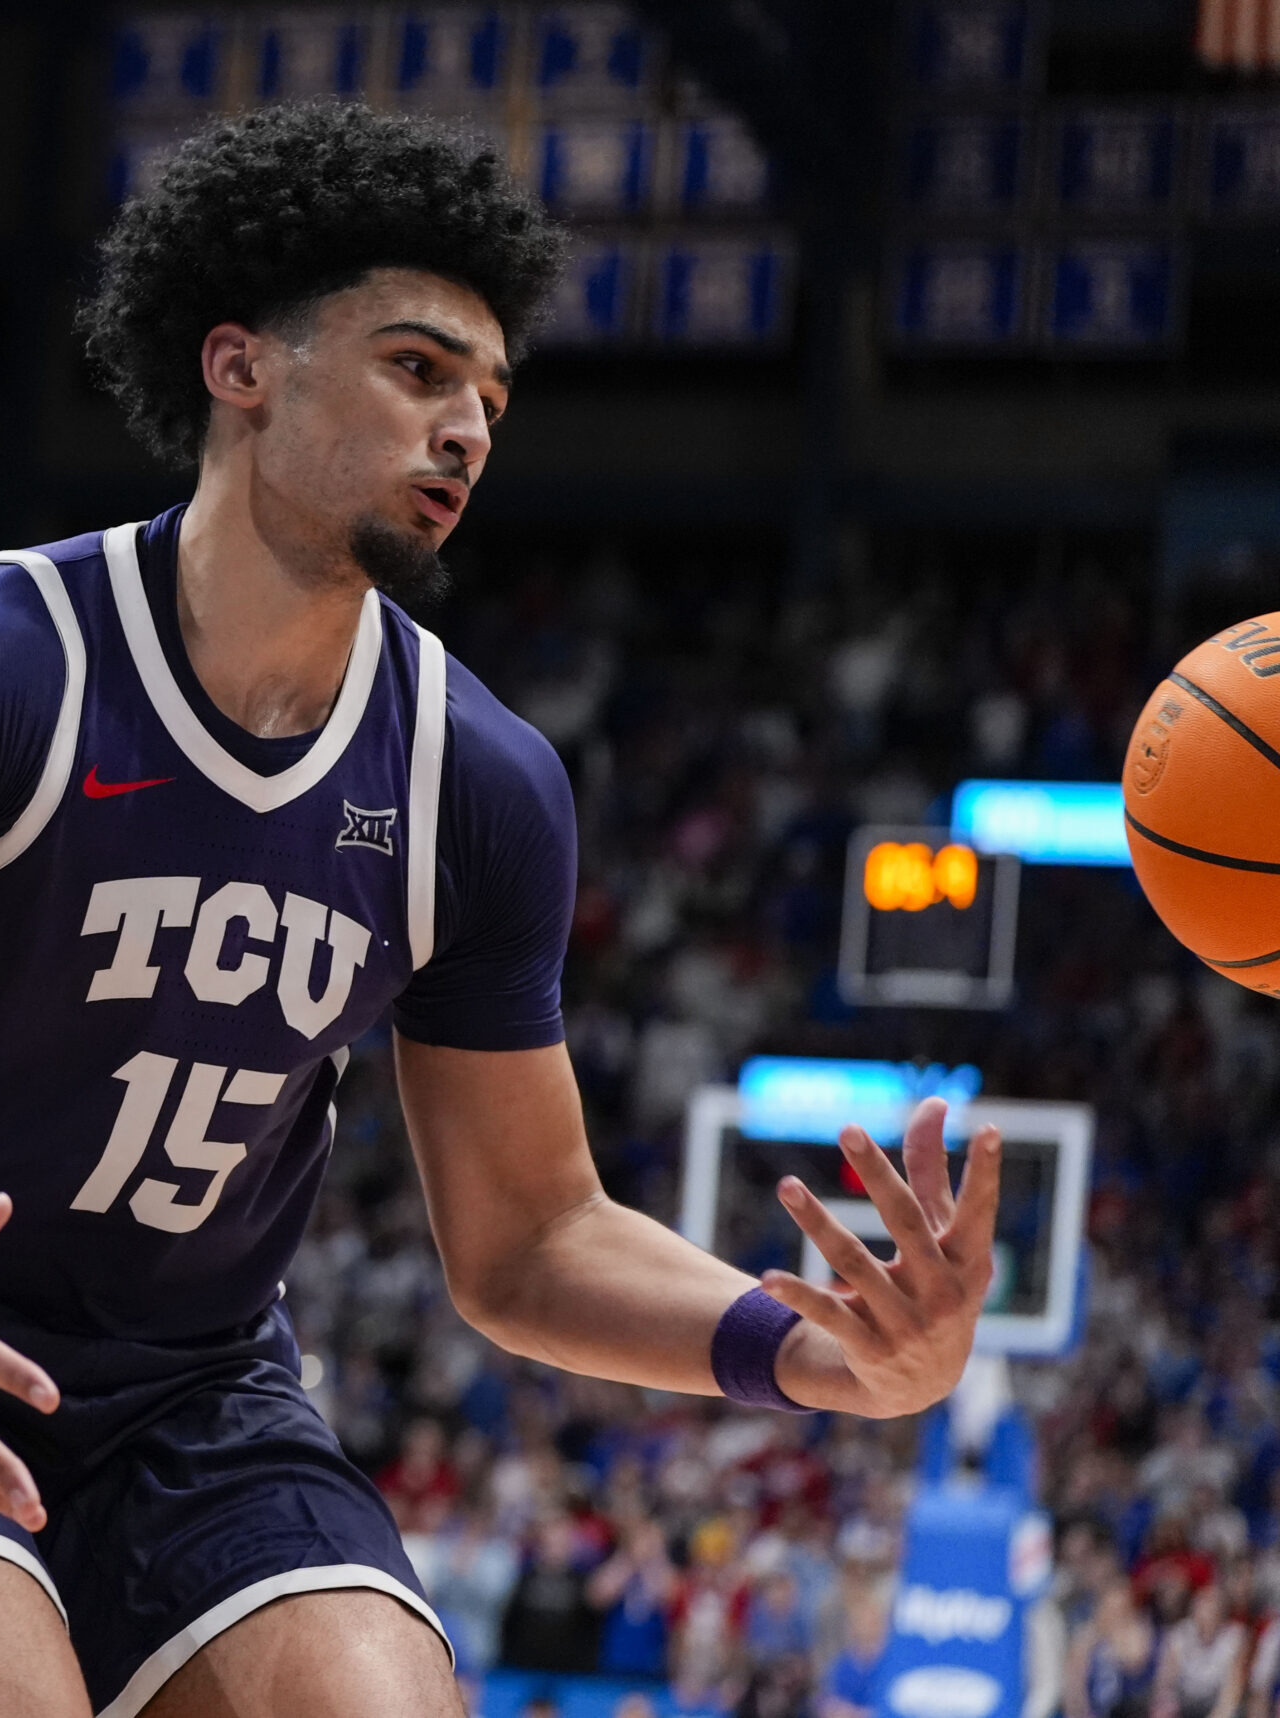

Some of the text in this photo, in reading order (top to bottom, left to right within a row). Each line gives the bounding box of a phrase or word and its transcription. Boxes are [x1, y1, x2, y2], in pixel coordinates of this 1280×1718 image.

[336, 799, 397, 856] XII
[80, 876, 372, 1040] TCU
[69, 1051, 288, 1234] 15
